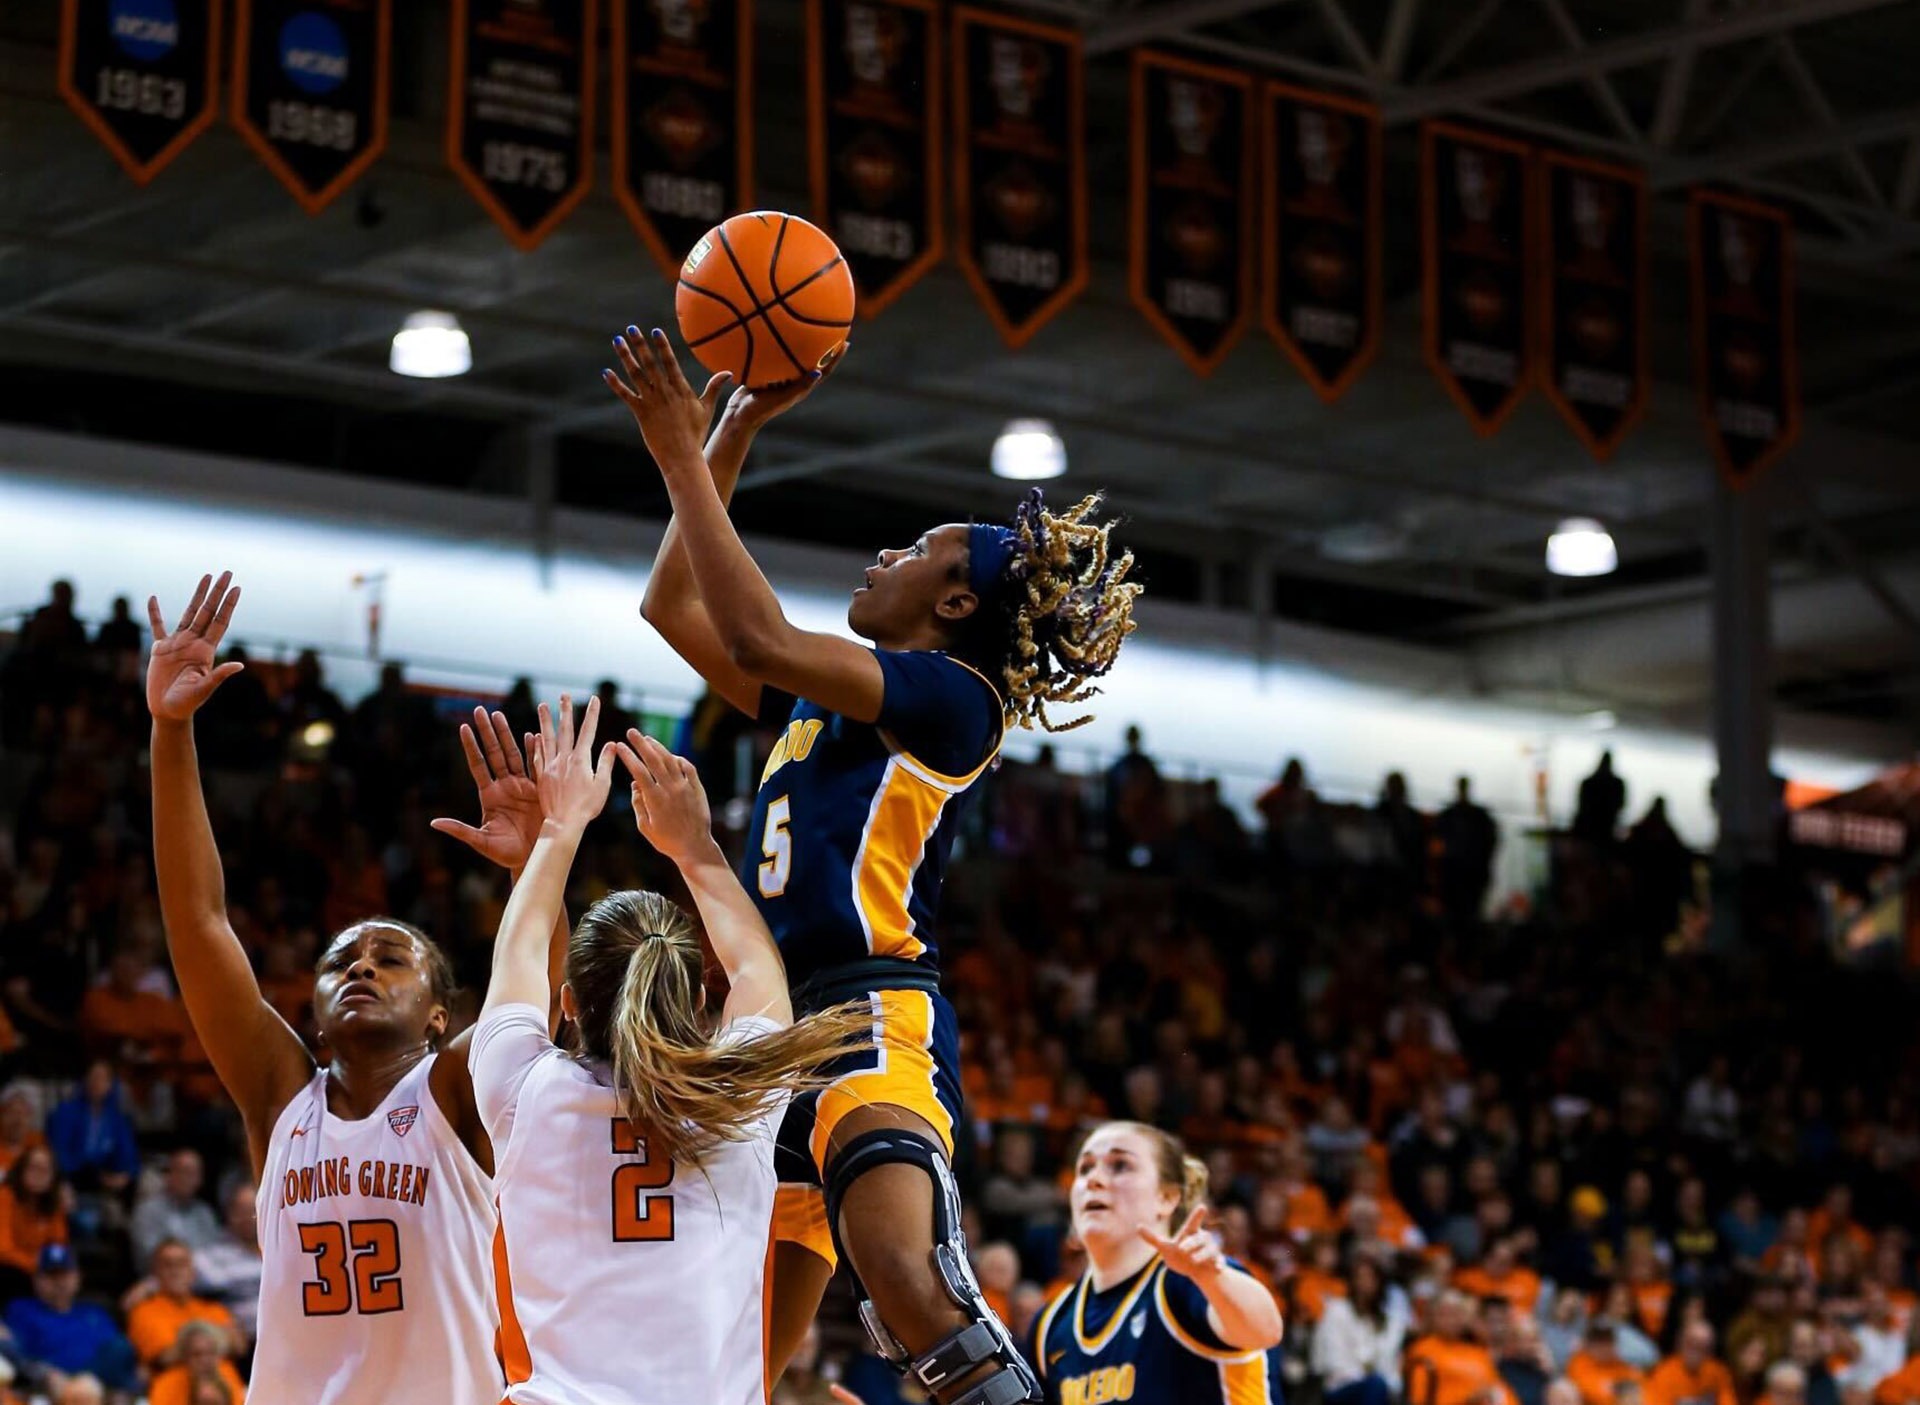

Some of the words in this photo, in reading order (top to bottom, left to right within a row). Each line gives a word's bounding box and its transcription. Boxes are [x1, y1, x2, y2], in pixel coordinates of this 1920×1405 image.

[757, 794, 792, 899] 5
[281, 1156, 350, 1209] OWING
[358, 1160, 430, 1208] GREEN
[610, 1116, 675, 1243] 2
[297, 1218, 404, 1317] 32
